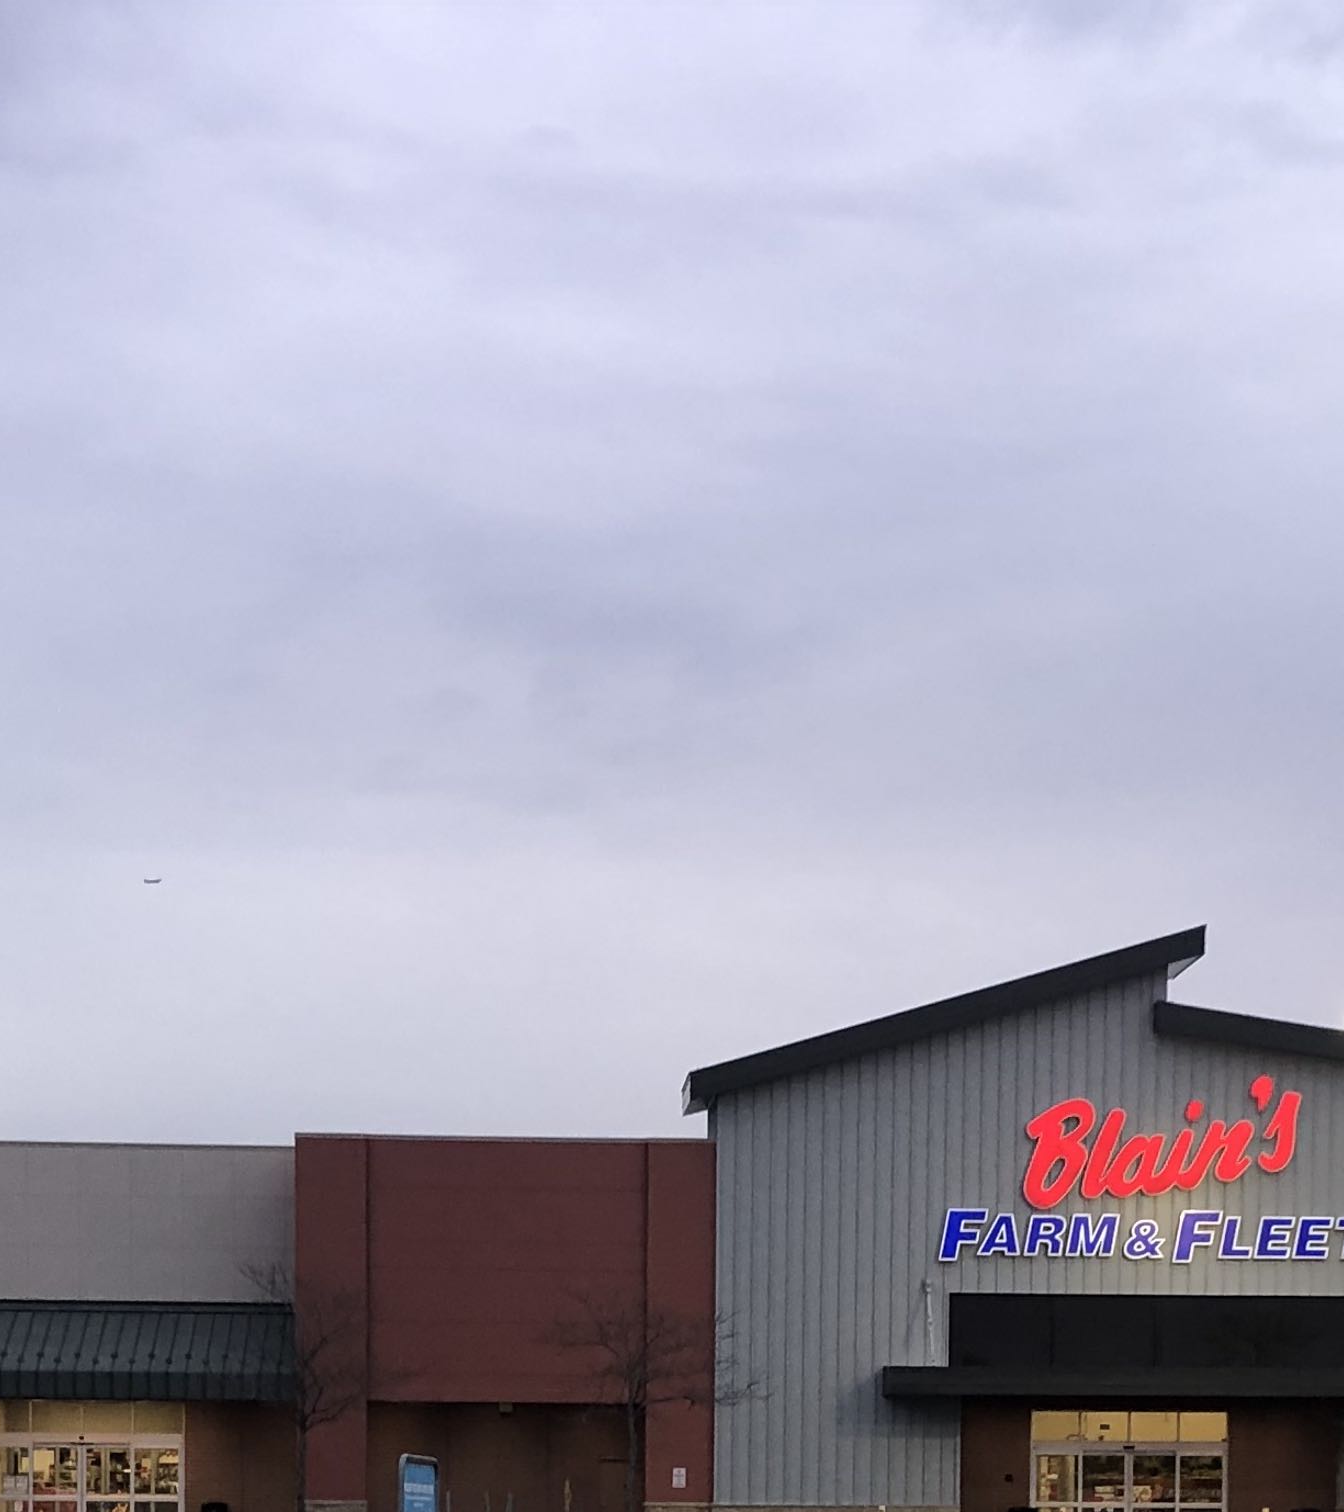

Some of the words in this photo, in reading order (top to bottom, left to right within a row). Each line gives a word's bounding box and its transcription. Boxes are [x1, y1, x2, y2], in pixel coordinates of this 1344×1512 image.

[1023, 1073, 1302, 1209] Blain's
[938, 1207, 1118, 1262] FARM
[1124, 1218, 1163, 1259] &
